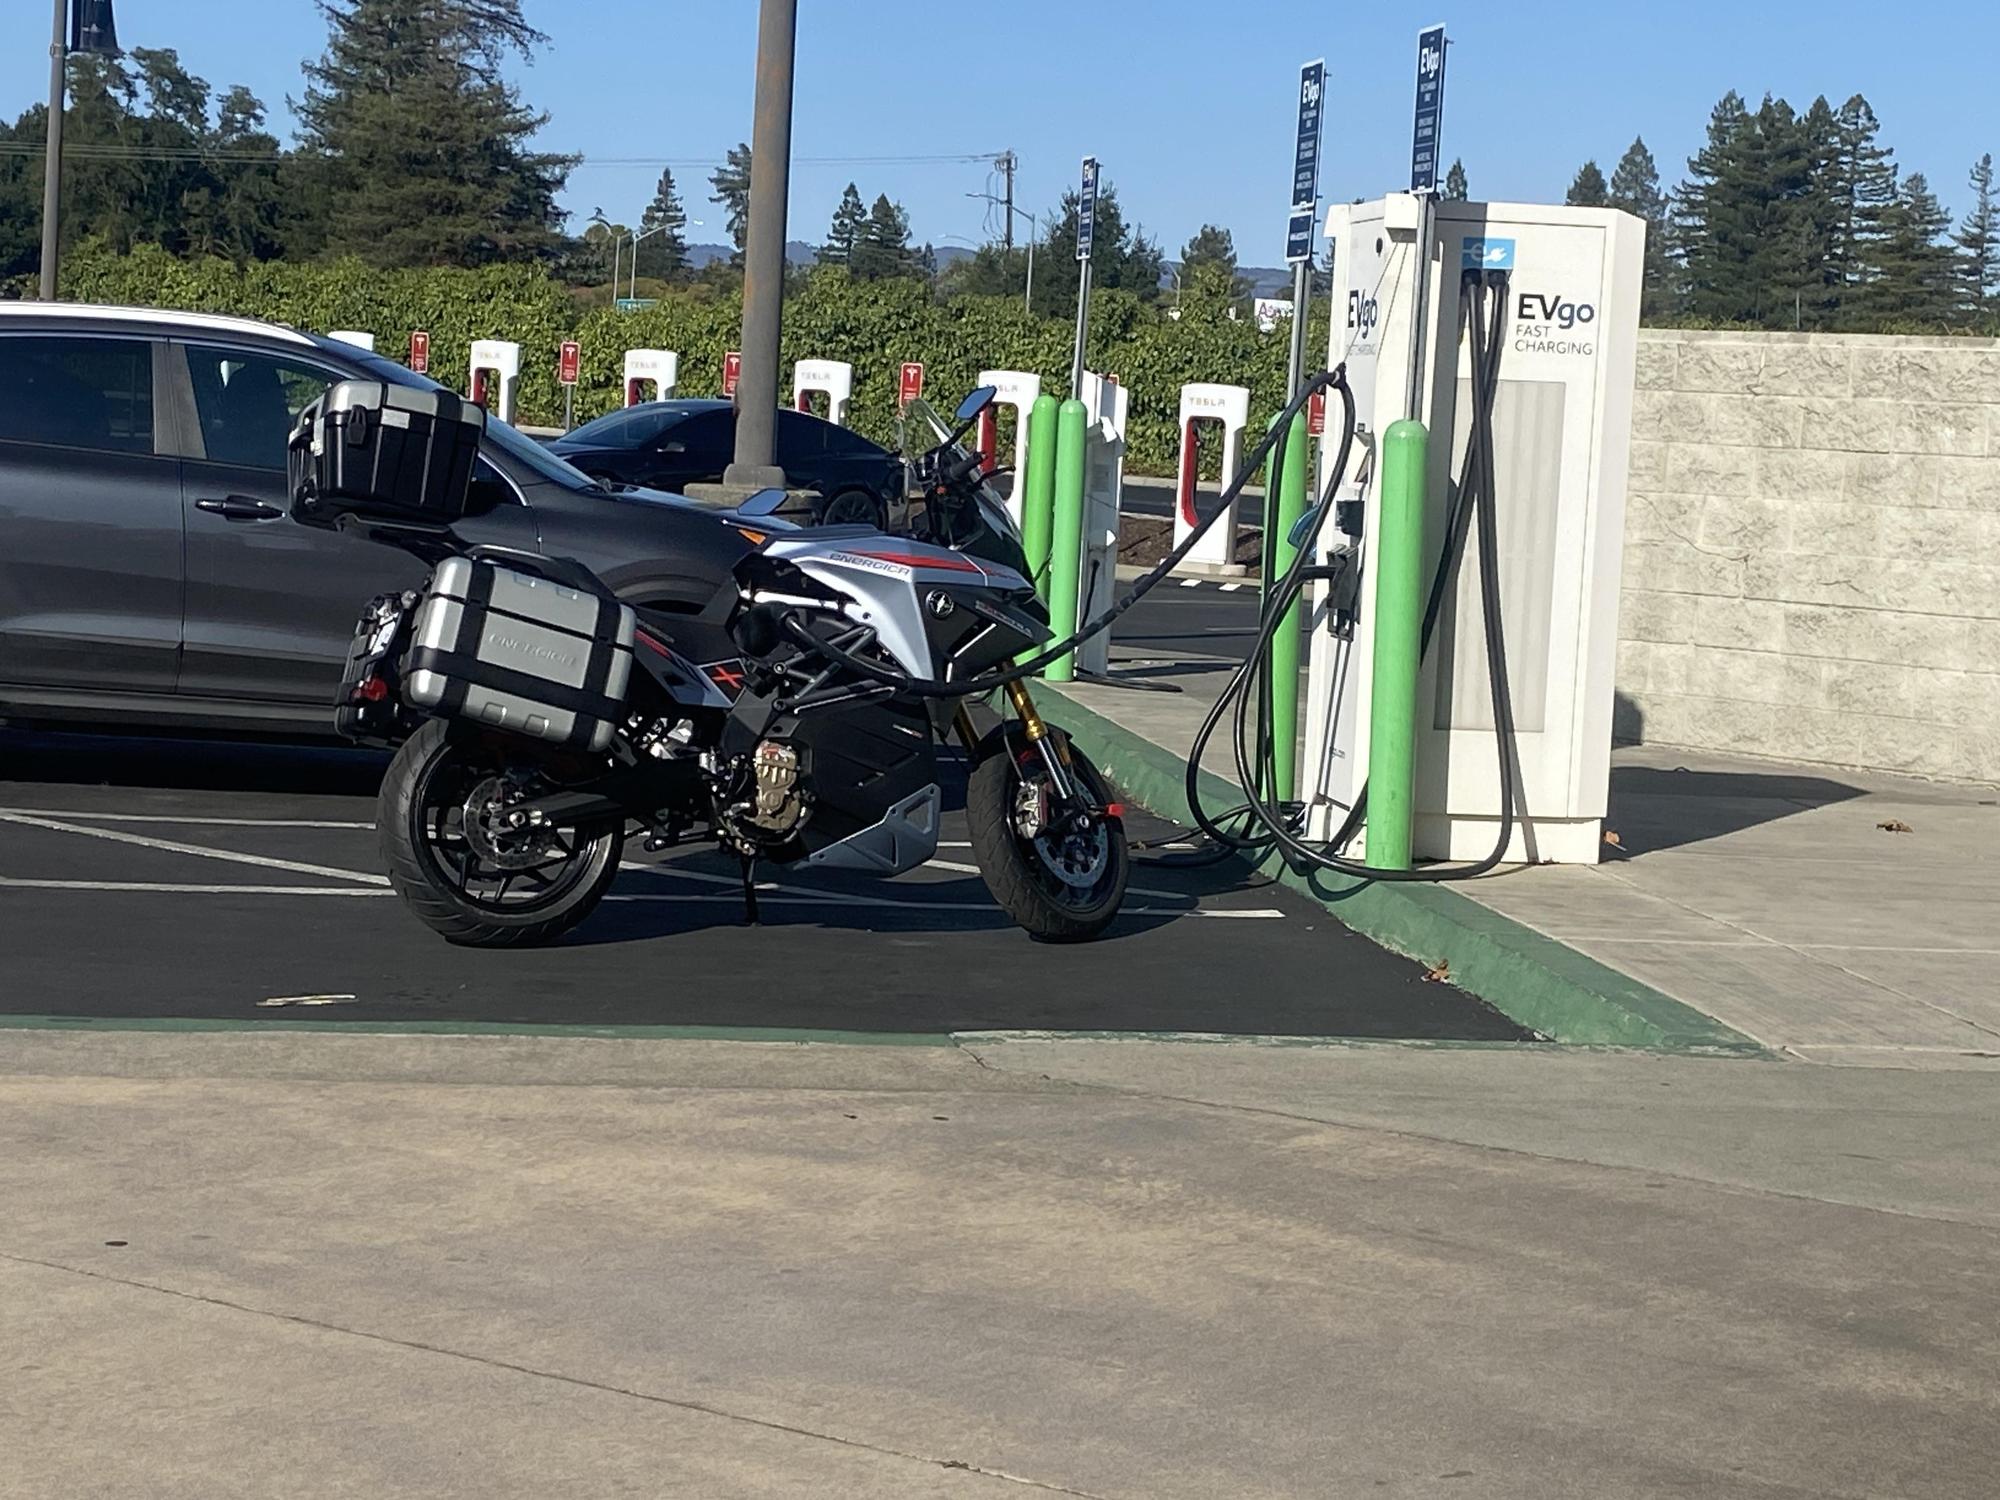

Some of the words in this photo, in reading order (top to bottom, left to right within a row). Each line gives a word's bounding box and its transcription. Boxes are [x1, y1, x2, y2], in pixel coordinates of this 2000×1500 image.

[1421, 46, 1440, 79] EVgo
[1302, 79, 1320, 107] EVgo
[1348, 288, 1377, 339] EVgo
[1518, 293, 1594, 329] EVgo
[1516, 324, 1551, 337] FAST
[1515, 339, 1593, 355] CHARGING
[1189, 397, 1225, 407] TESLA
